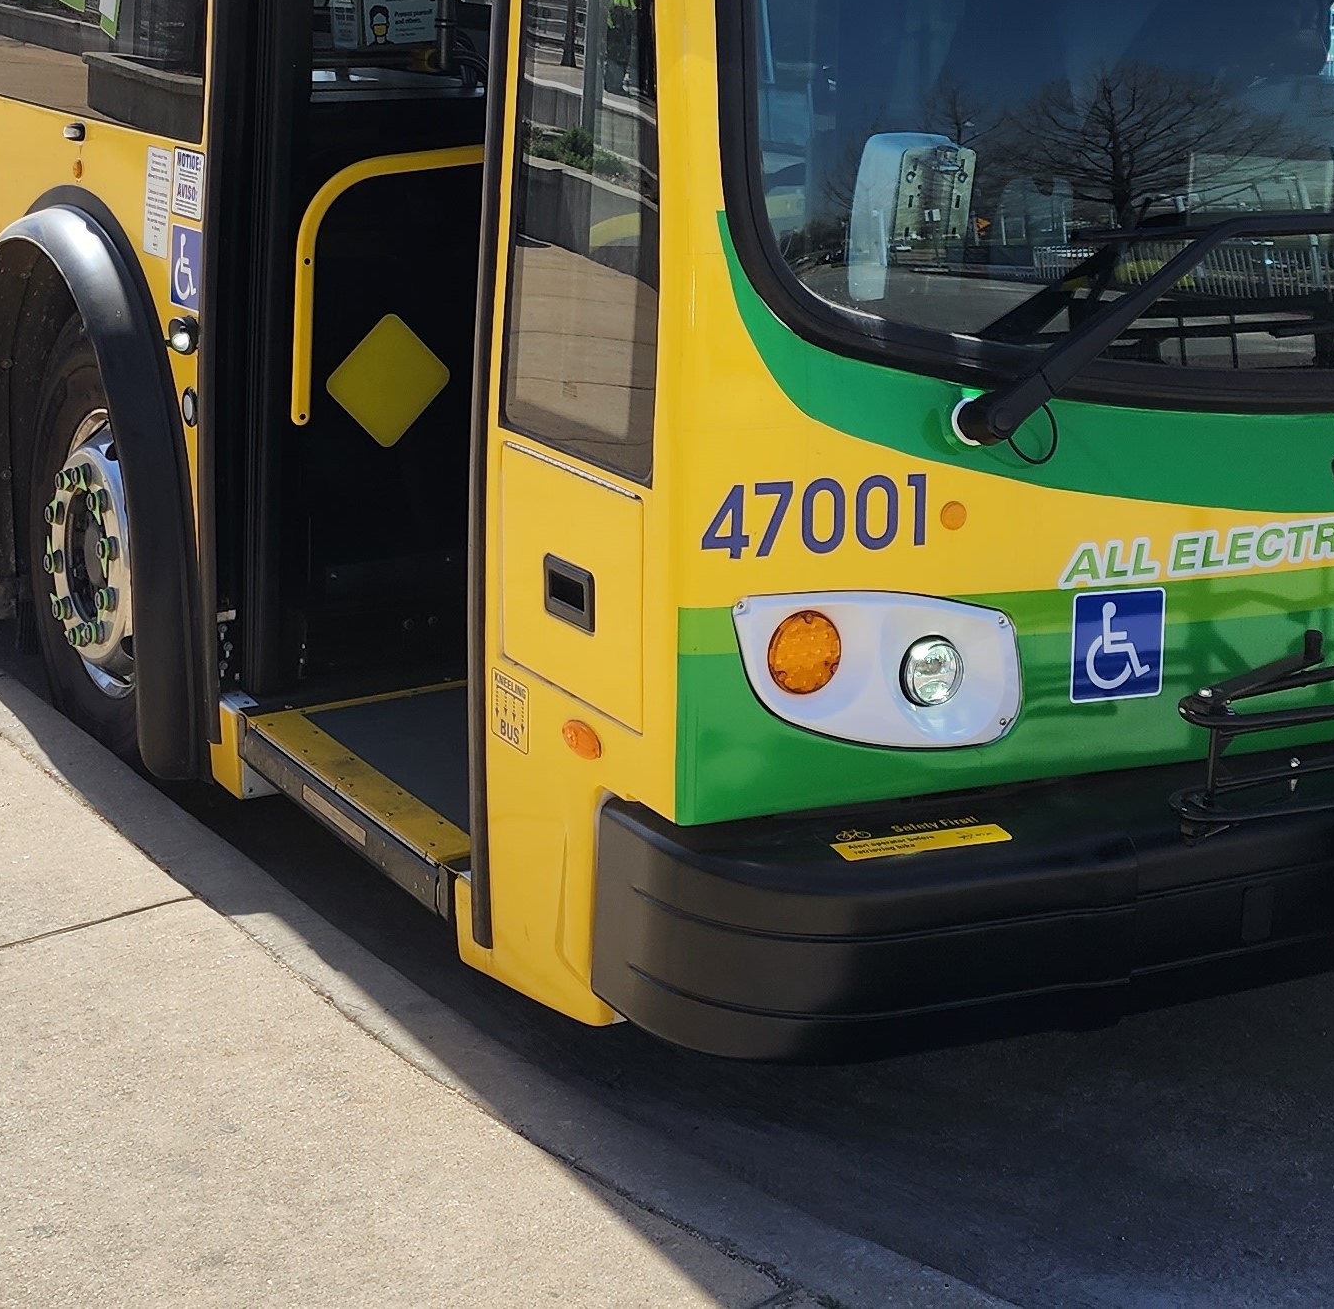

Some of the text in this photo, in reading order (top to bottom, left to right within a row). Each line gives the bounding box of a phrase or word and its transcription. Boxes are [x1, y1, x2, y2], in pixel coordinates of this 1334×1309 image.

[700, 473, 927, 560] 47001
[1060, 539, 1158, 586] ALL
[494, 671, 527, 700] KNEELING
[500, 718, 520, 745] BUS
